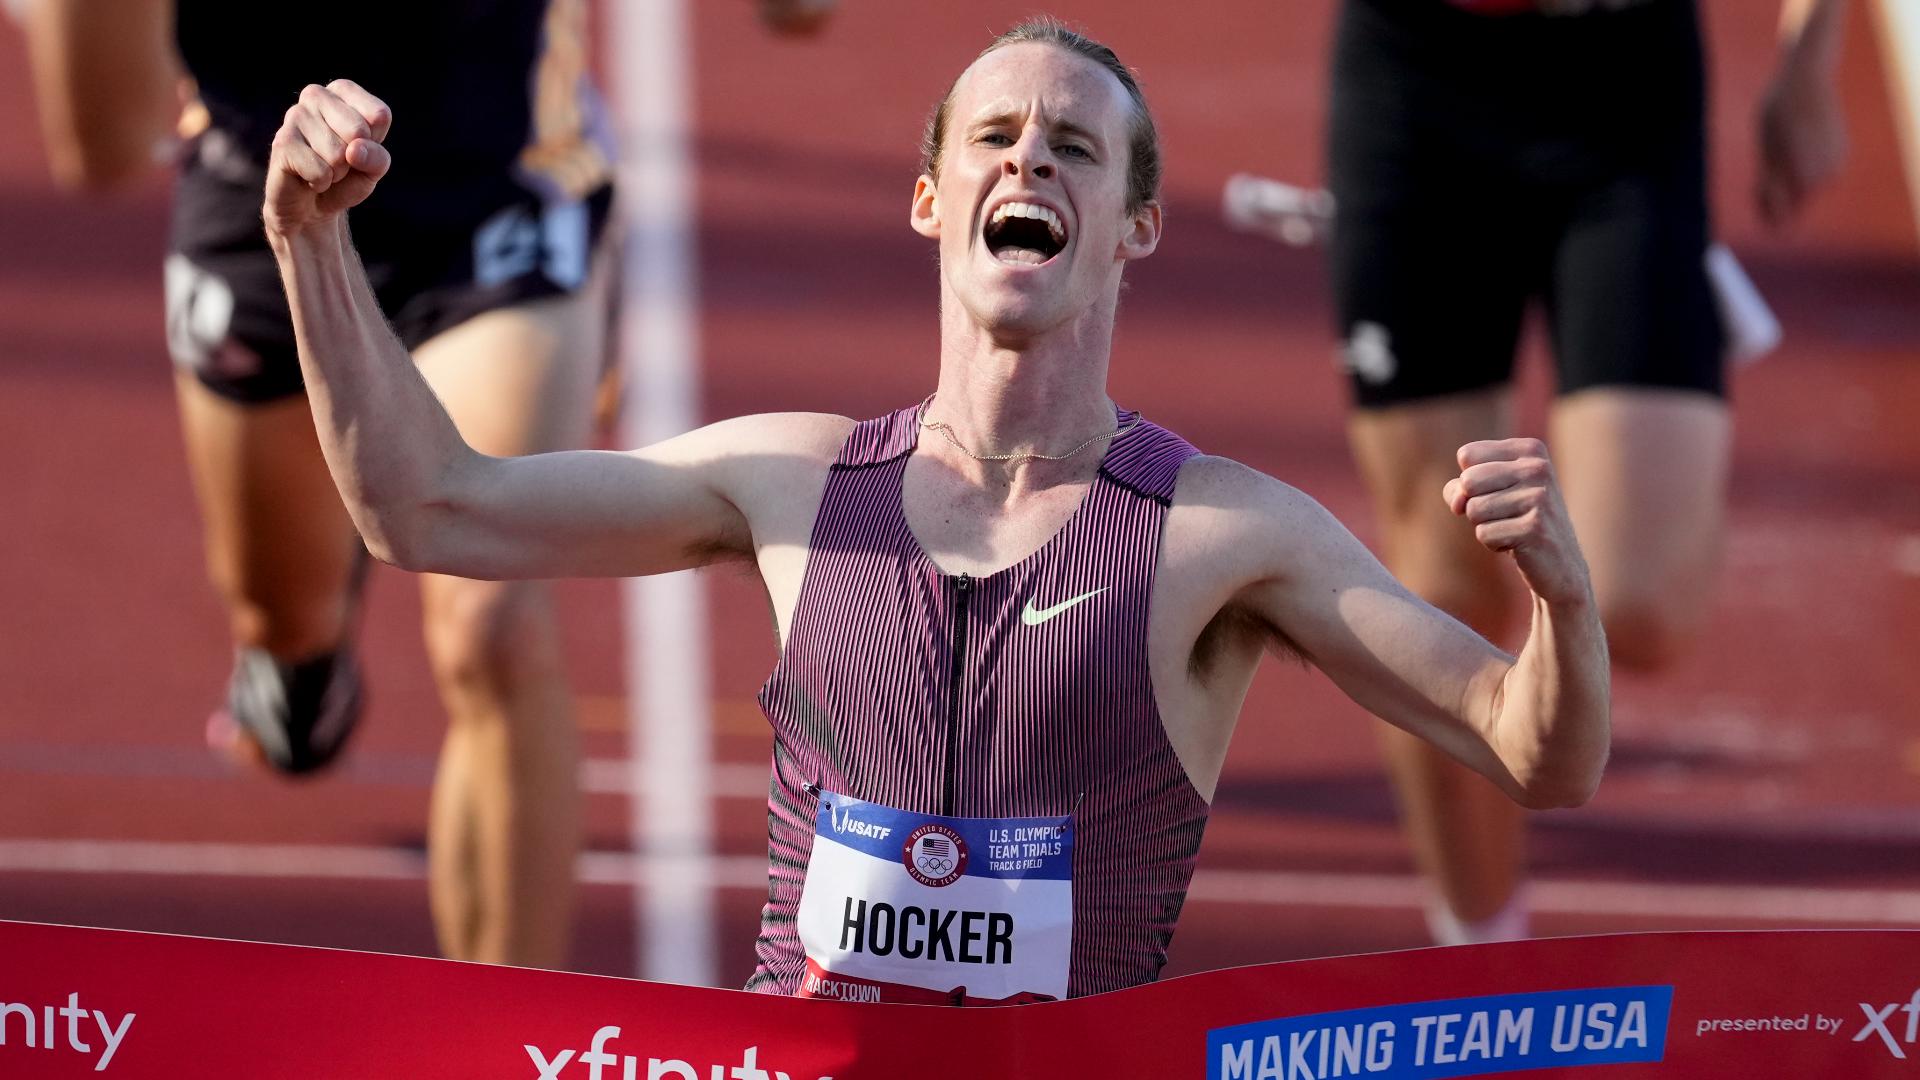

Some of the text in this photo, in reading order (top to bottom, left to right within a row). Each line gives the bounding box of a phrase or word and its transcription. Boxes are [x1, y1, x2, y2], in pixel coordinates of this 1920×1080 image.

[847, 819, 891, 840] USATF
[911, 826, 962, 846] UNITED STATES
[989, 826, 1061, 843] U.S. OLYMPIC
[988, 841, 1062, 859] TEAM TRIALS
[989, 858, 1043, 871] TRACK & FIELD
[909, 866, 960, 887] OLYMPIC TEAM
[838, 896, 1014, 964] HOCKER
[0, 991, 137, 1072] nity
[1696, 1013, 1844, 1037] presented by
[1221, 1000, 1648, 1080] MAKING TEAM USA
[523, 1025, 834, 1080] xfint
